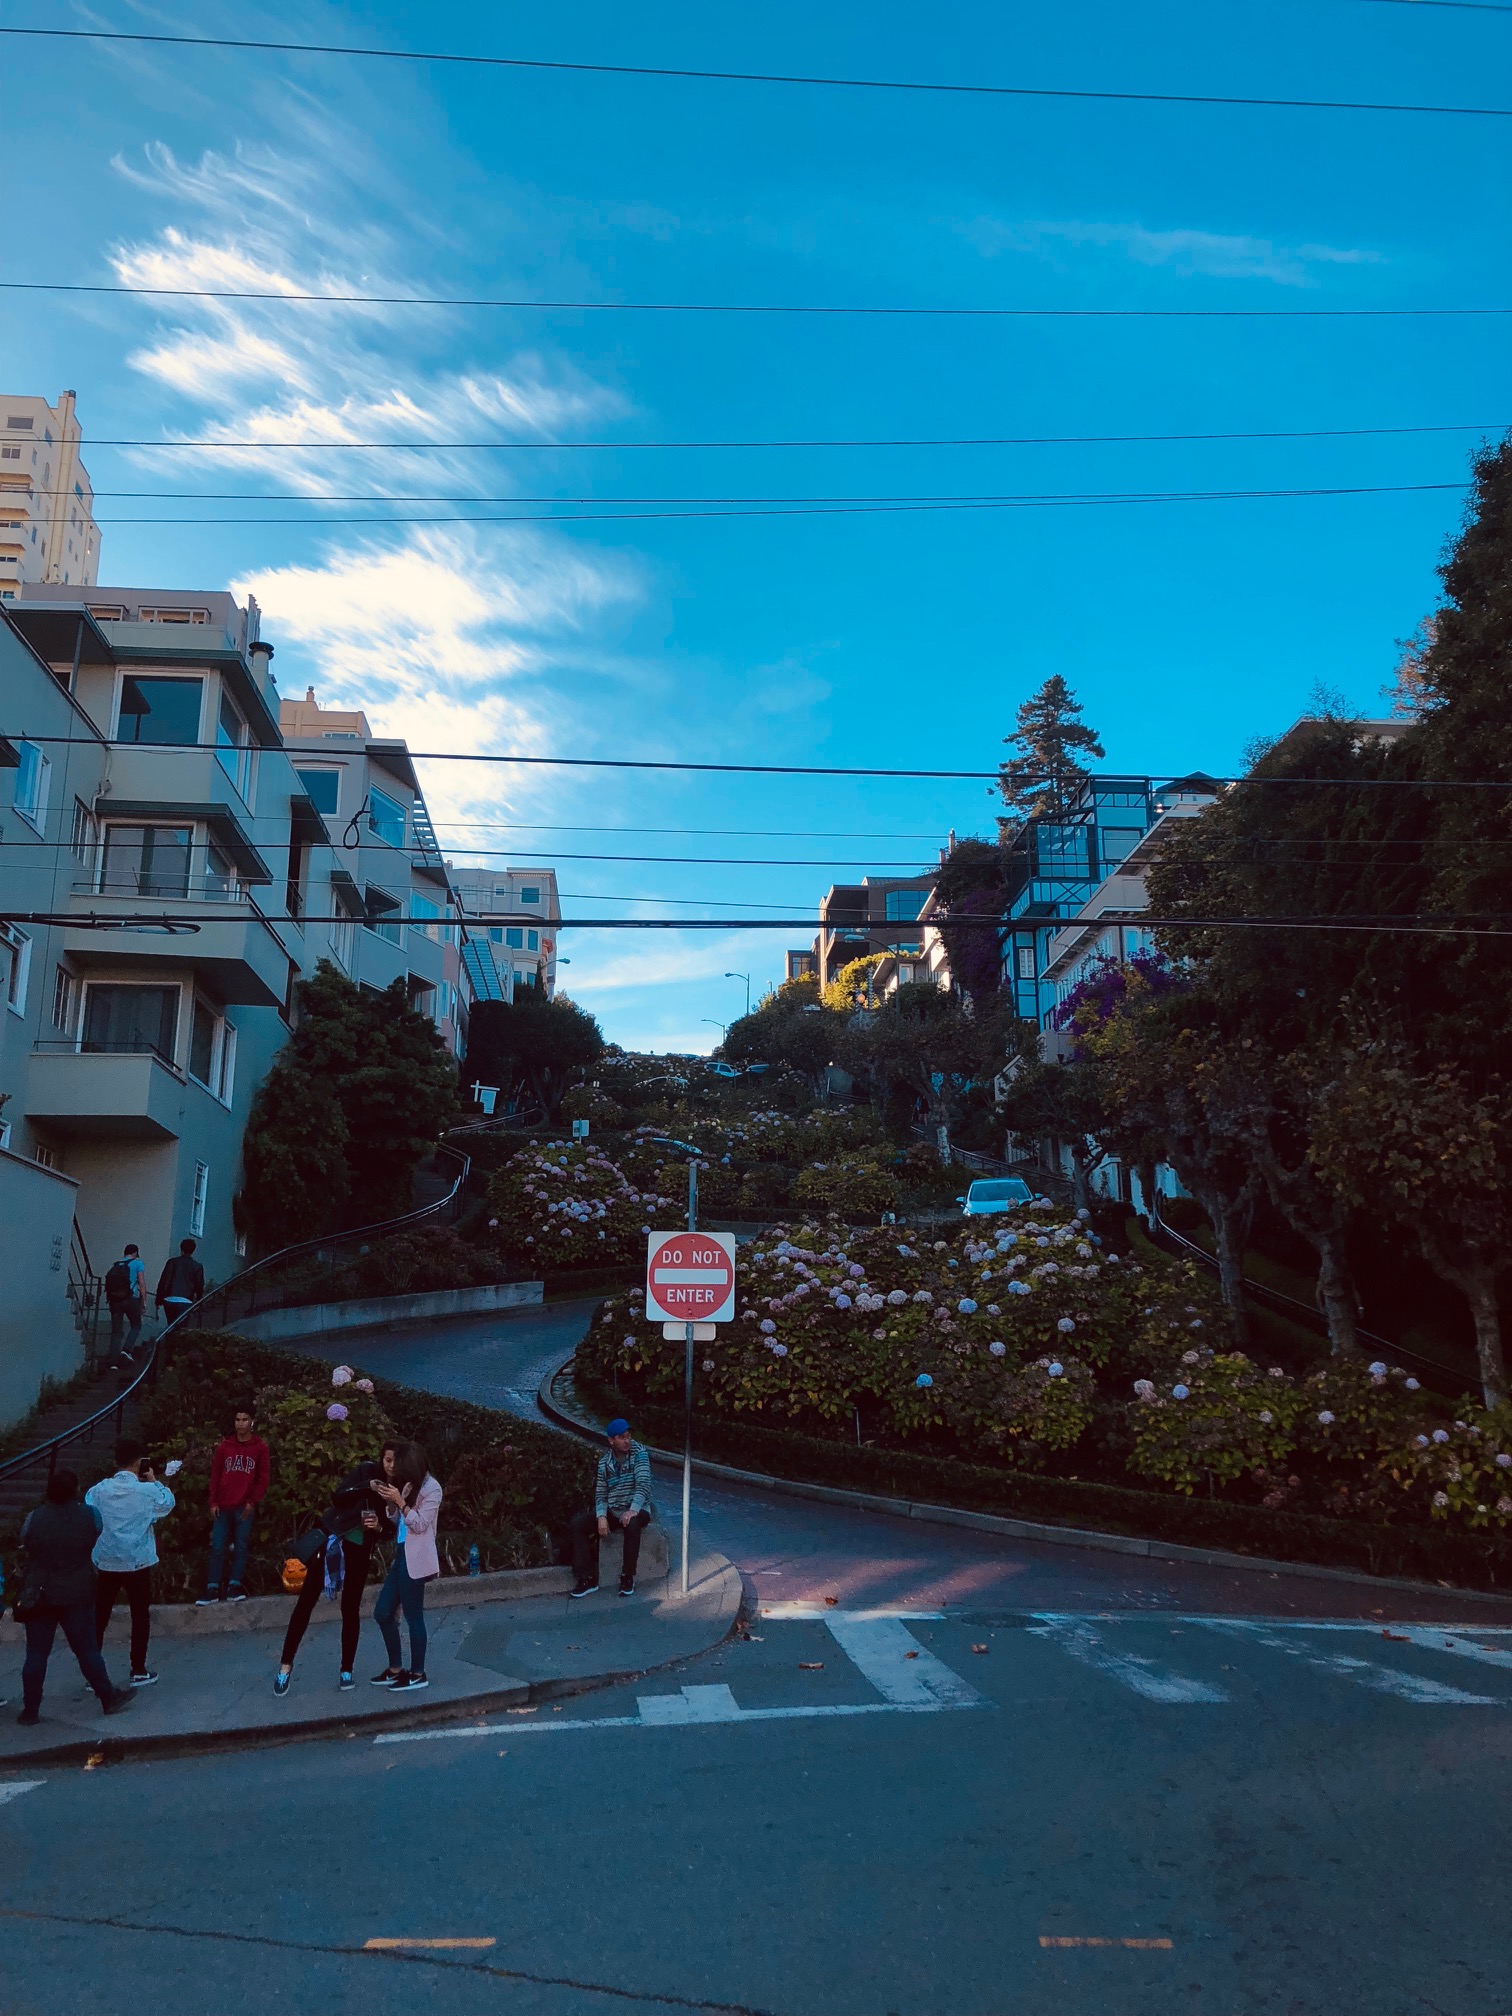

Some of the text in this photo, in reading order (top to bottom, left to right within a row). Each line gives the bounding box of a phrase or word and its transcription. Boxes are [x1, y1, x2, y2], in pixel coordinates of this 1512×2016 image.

[662, 1250, 722, 1264] DO NOT
[666, 1289, 715, 1303] ENTER
[224, 1454, 256, 1474] GAP
